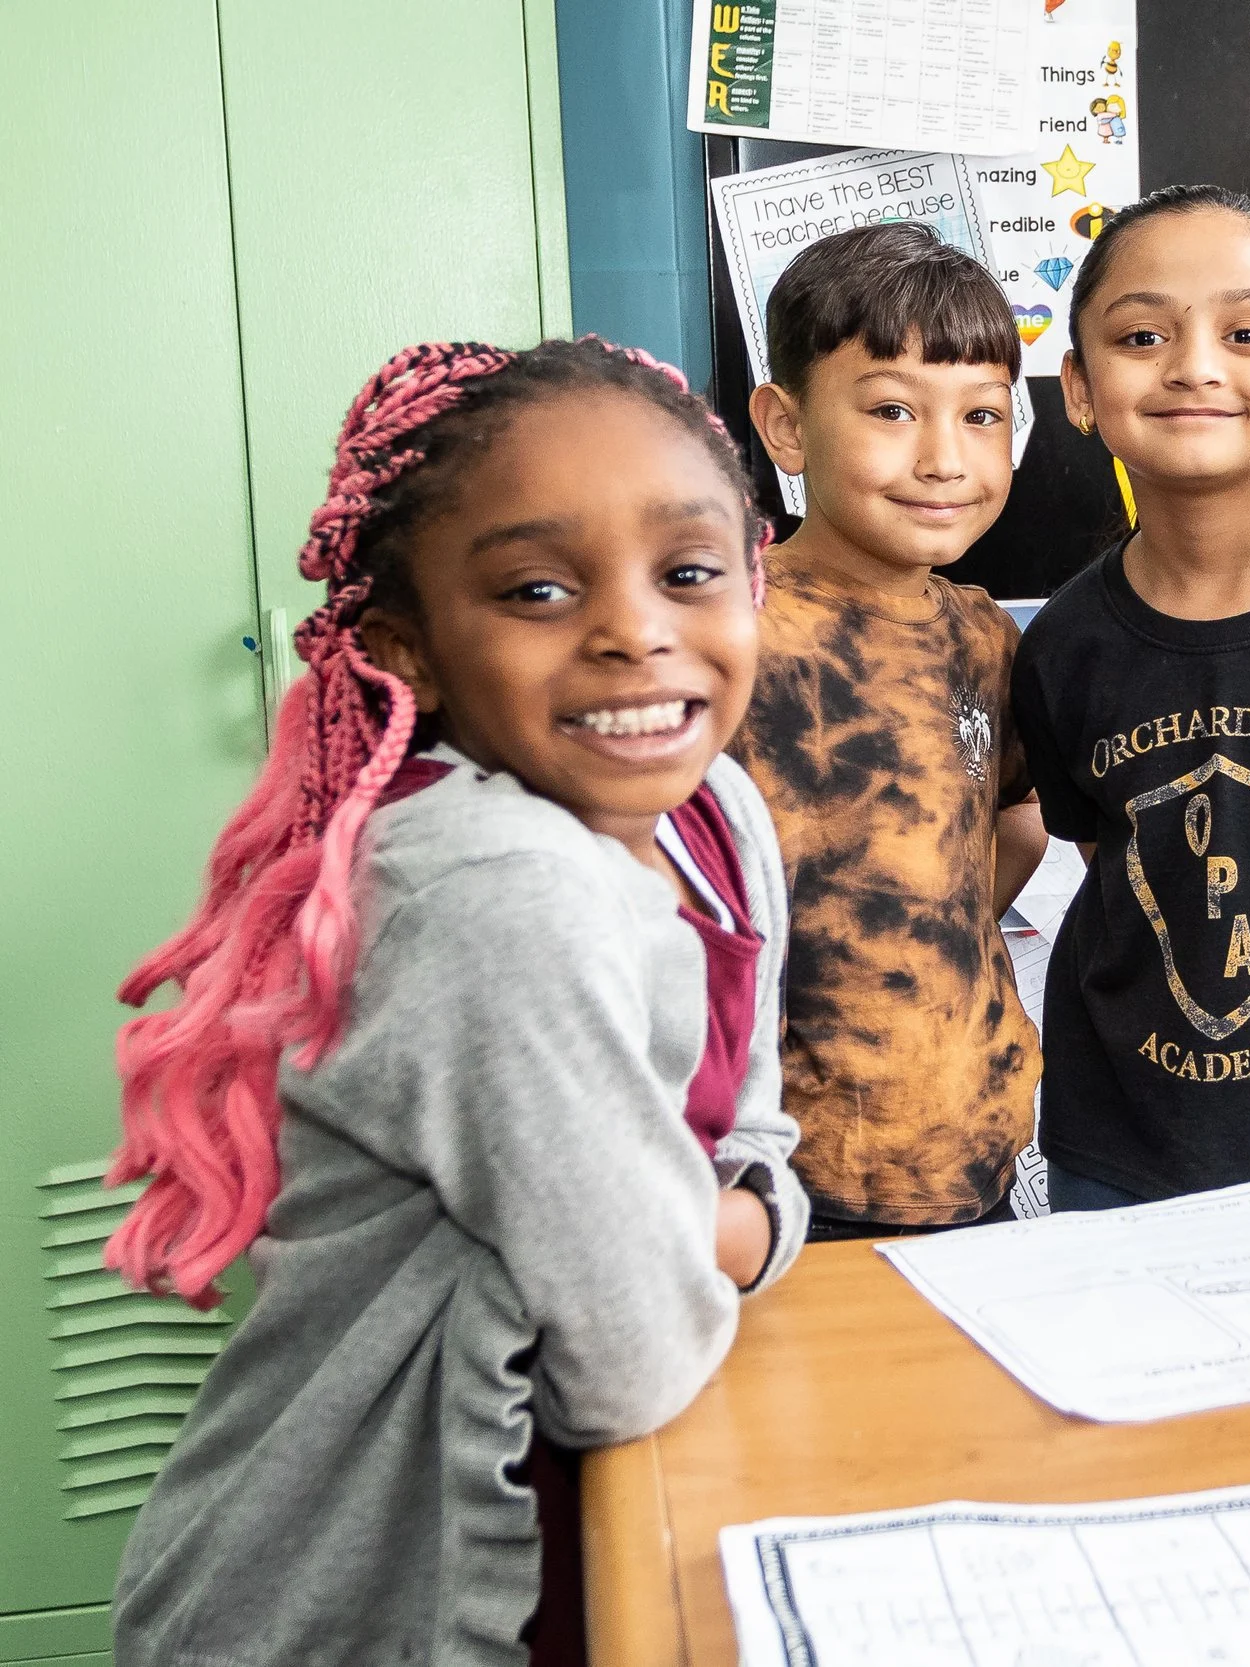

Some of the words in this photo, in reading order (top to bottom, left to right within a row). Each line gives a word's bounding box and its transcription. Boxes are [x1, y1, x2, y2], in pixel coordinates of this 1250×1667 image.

[1040, 66, 1095, 85] Things
[754, 201, 761, 222] I
[763, 194, 825, 221] have
[829, 181, 874, 206] the
[877, 163, 935, 196] BEST
[750, 215, 845, 250] teacher
